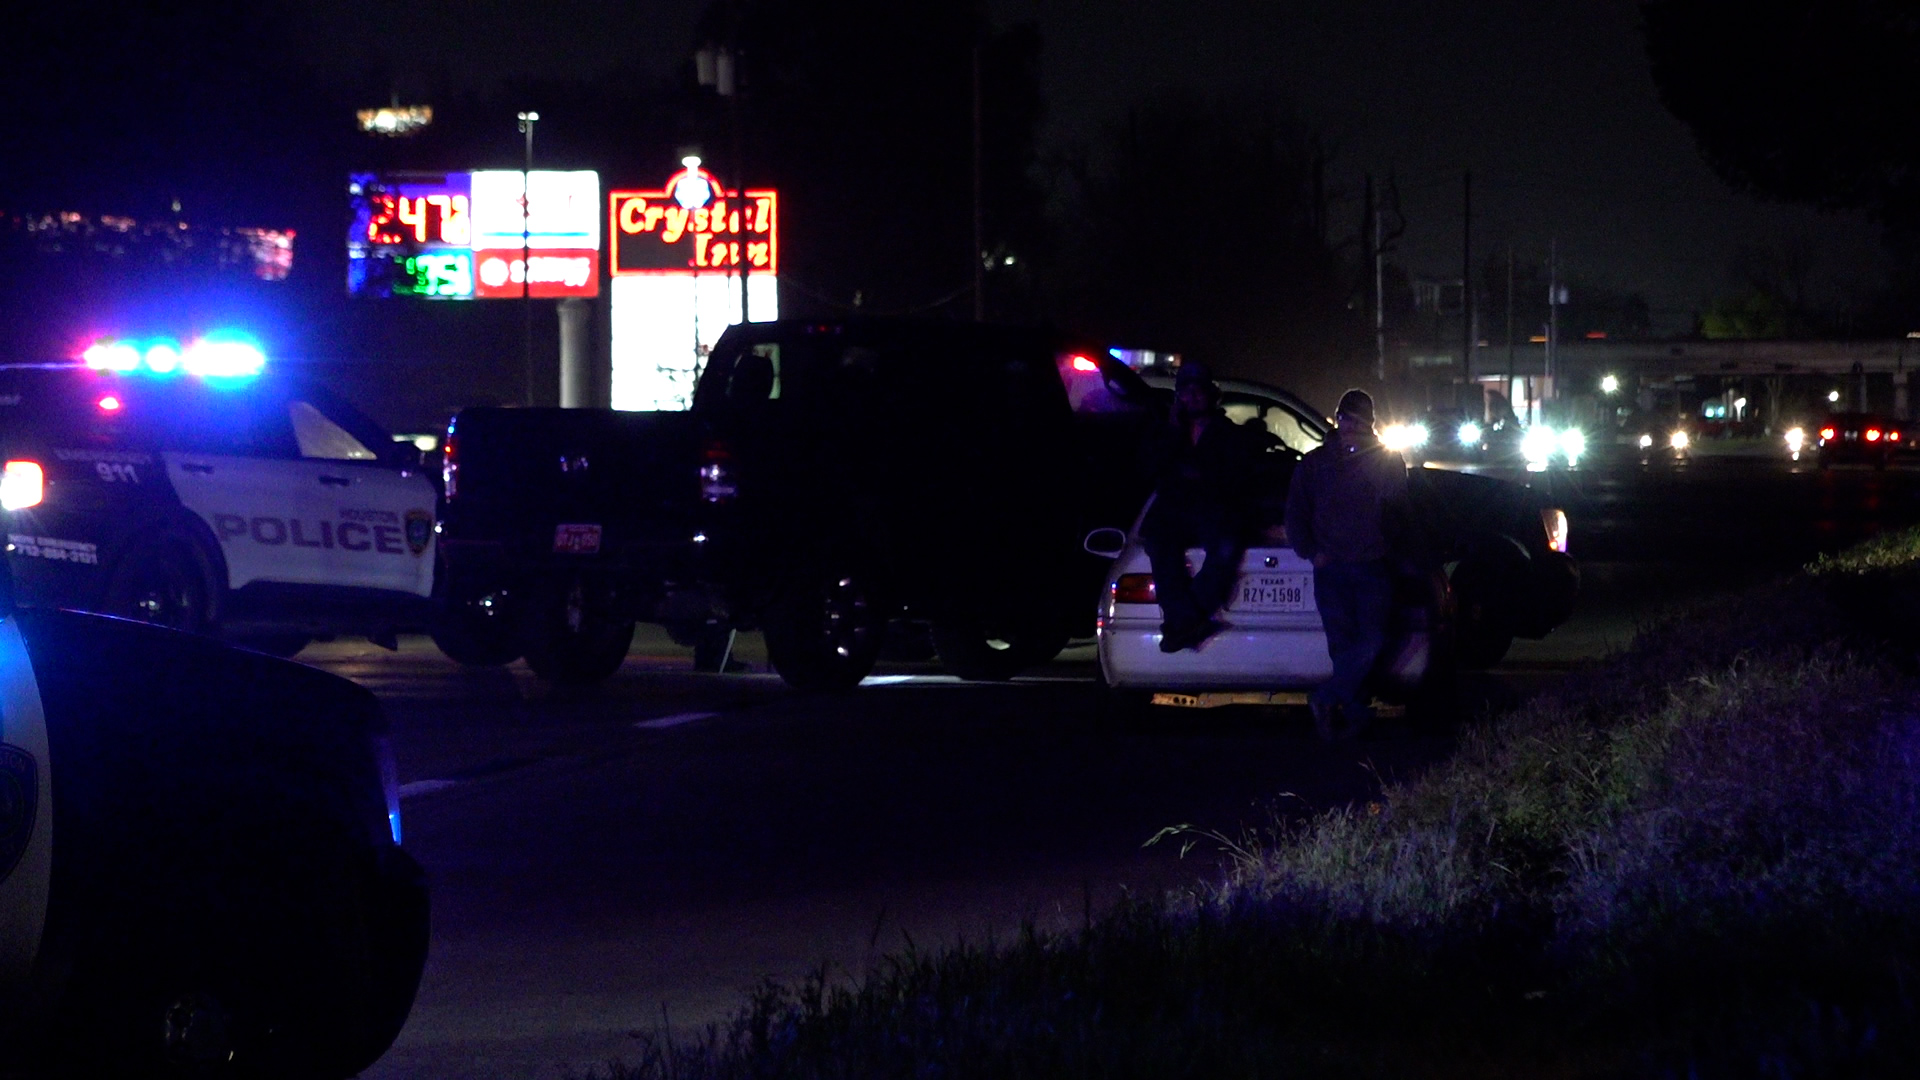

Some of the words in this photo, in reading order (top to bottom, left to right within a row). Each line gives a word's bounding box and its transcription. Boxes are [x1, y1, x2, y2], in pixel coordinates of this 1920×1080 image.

[619, 197, 771, 243] Crystal
[695, 232, 769, 267] Inn
[96, 462, 138, 484] 911
[214, 512, 404, 555] POLICE
